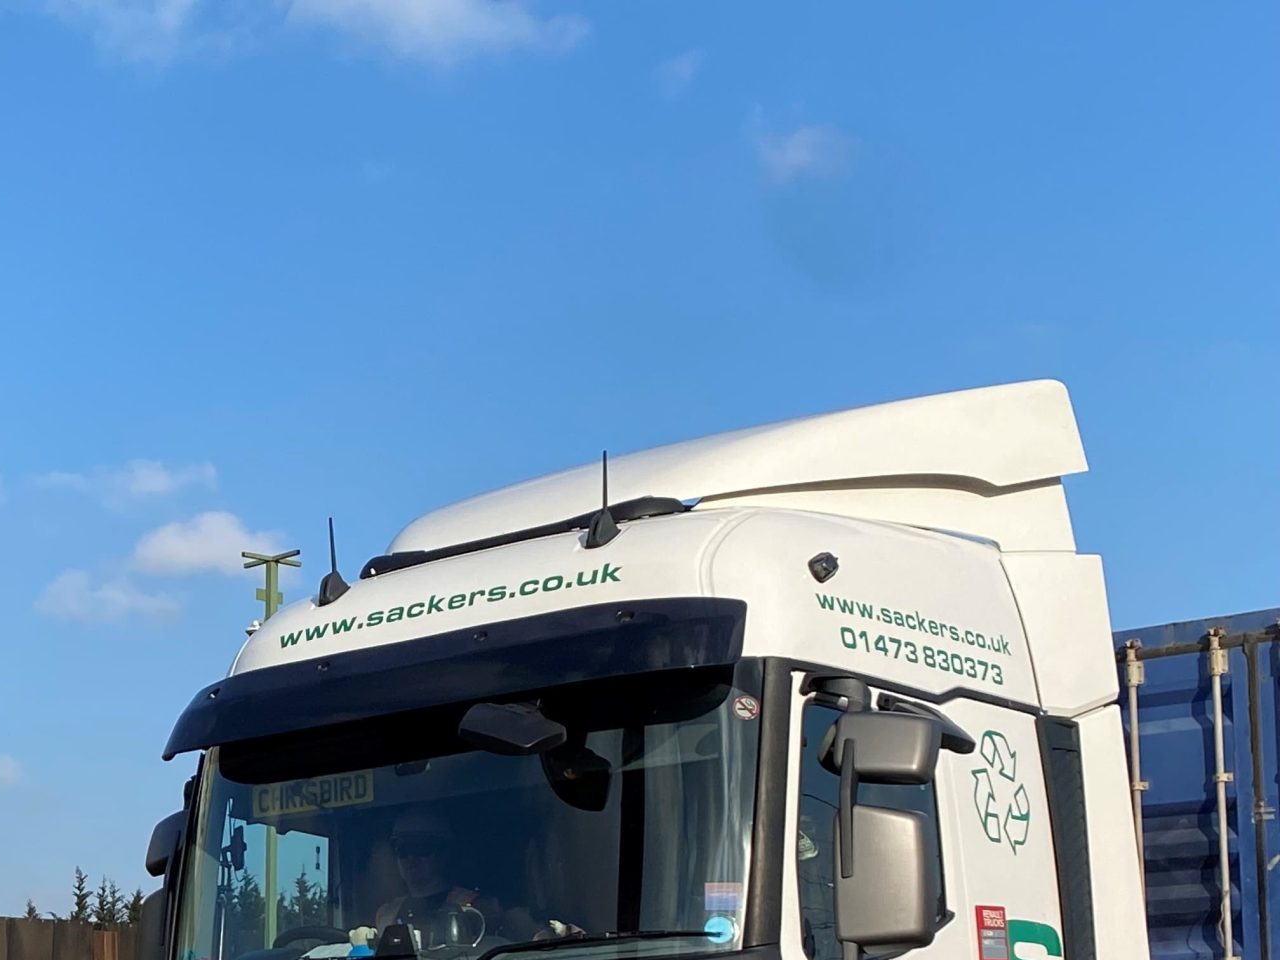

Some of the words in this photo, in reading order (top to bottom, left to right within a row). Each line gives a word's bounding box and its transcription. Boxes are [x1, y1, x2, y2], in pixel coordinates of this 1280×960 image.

[280, 563, 623, 648] www.sackers.co.uk
[815, 593, 1012, 655] www.sackers.co.uk
[840, 626, 918, 664] 01473
[923, 646, 1004, 685] 830373
